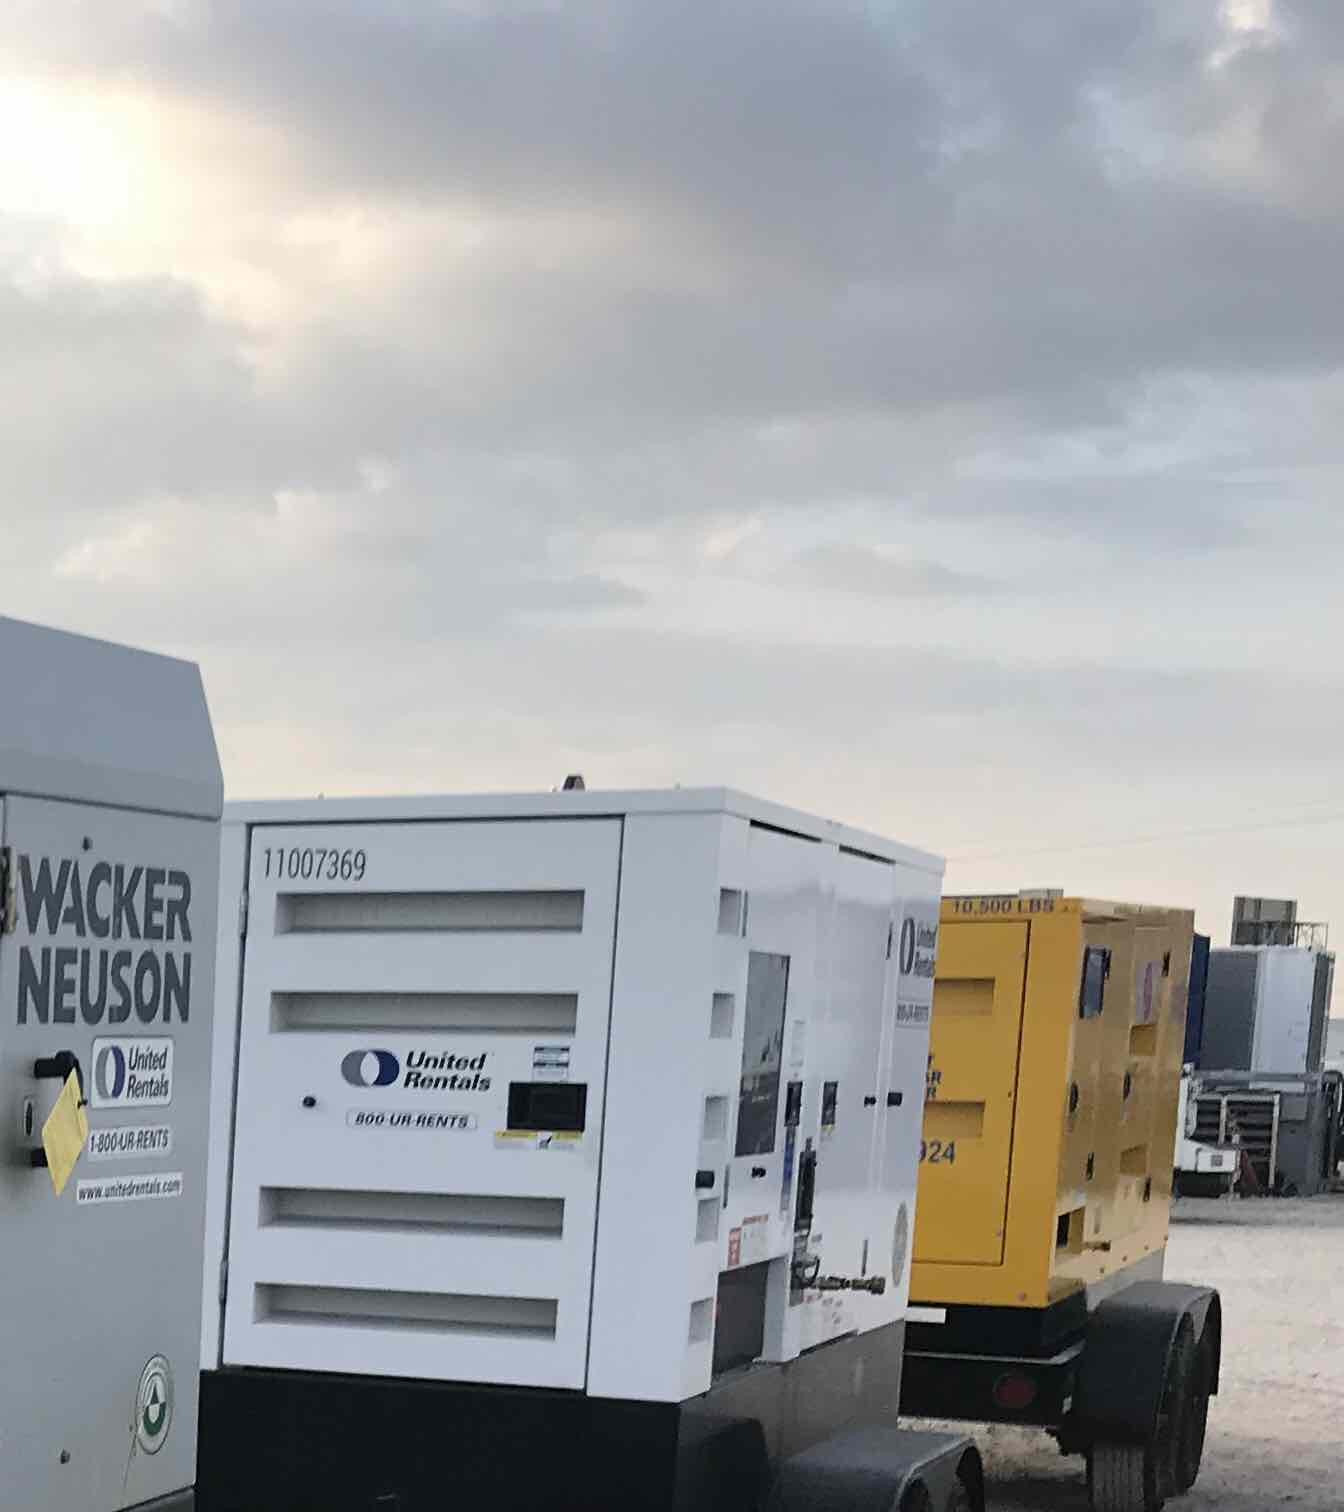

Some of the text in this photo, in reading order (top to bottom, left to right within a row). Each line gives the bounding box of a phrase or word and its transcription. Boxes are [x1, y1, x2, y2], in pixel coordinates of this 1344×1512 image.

[263, 847, 367, 881] 11007369
[17, 854, 193, 942] WACKER
[16, 945, 192, 1025] NEUSON
[128, 1044, 168, 1072] United
[406, 1051, 488, 1071] United
[126, 1074, 170, 1100] Rentals
[404, 1072, 491, 1092] Rentals
[90, 1129, 169, 1153] 1-800-UR-RENTS
[78, 1178, 181, 1201] www.unitedrentals.com
